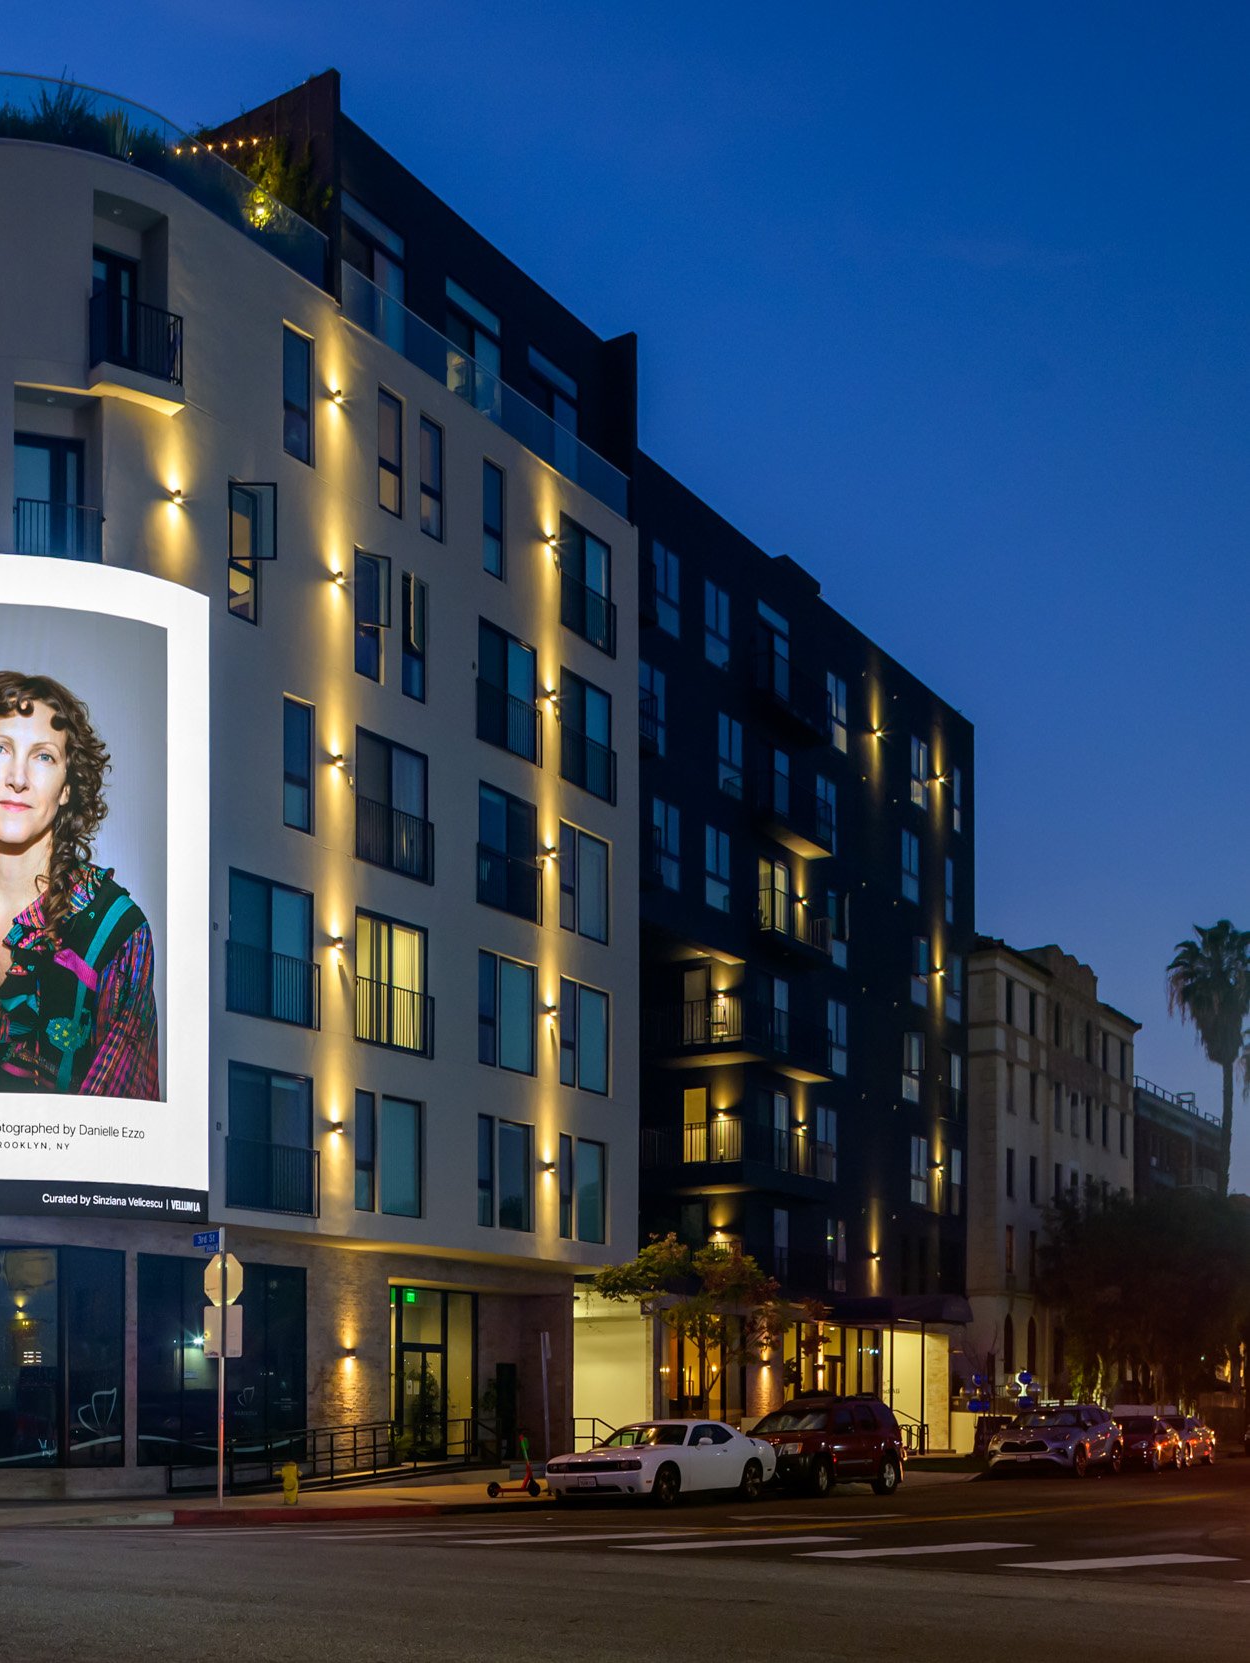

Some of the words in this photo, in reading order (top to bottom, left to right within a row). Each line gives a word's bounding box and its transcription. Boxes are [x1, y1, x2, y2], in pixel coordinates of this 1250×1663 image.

[63, 1123, 76, 1137] by
[79, 1124, 119, 1137] Danielle
[122, 1126, 145, 1139] Ezzo
[56, 1142, 70, 1150] NY
[42, 1193, 78, 1204] Curated
[80, 1194, 91, 1206] by
[93, 1195, 127, 1206] Sinziana
[128, 1196, 163, 1209] Velicescu
